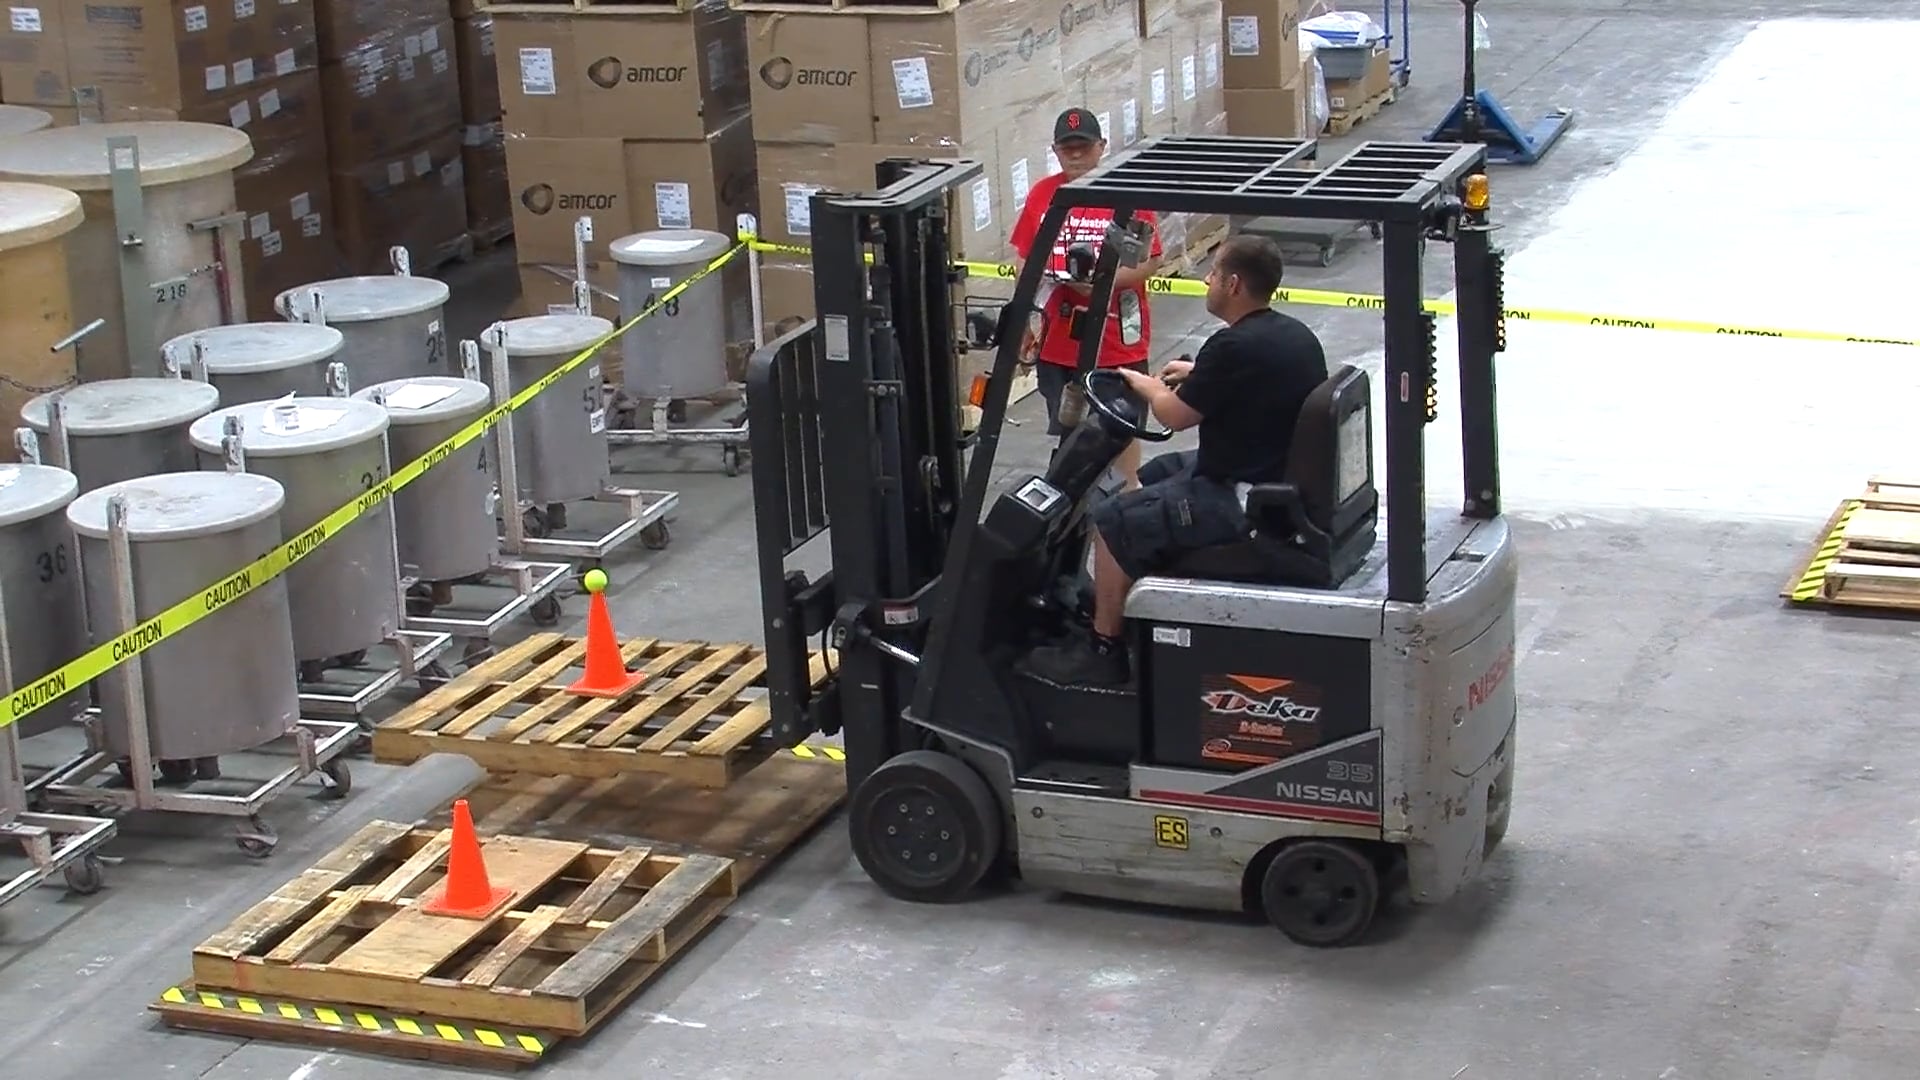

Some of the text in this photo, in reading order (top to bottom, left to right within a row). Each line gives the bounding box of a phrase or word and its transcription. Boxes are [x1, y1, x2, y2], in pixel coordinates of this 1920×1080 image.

[626, 64, 687, 83] amcor
[797, 67, 857, 87] amcor
[558, 193, 617, 211] amcor
[1070, 215, 1110, 229] Industria
[156, 283, 186, 304] 218
[1346, 296, 1385, 310] CAUT
[287, 524, 326, 561] CAUTION
[36, 543, 67, 584] 36
[204, 569, 251, 611] CAUTION
[112, 618, 163, 662] CAUTION
[1467, 642, 1514, 712] NISS
[10, 671, 66, 717] CAUTION
[1200, 690, 1320, 722] Deka
[1326, 760, 1374, 784] 35
[1276, 781, 1374, 807] NISSAN
[1159, 821, 1185, 844] ES
